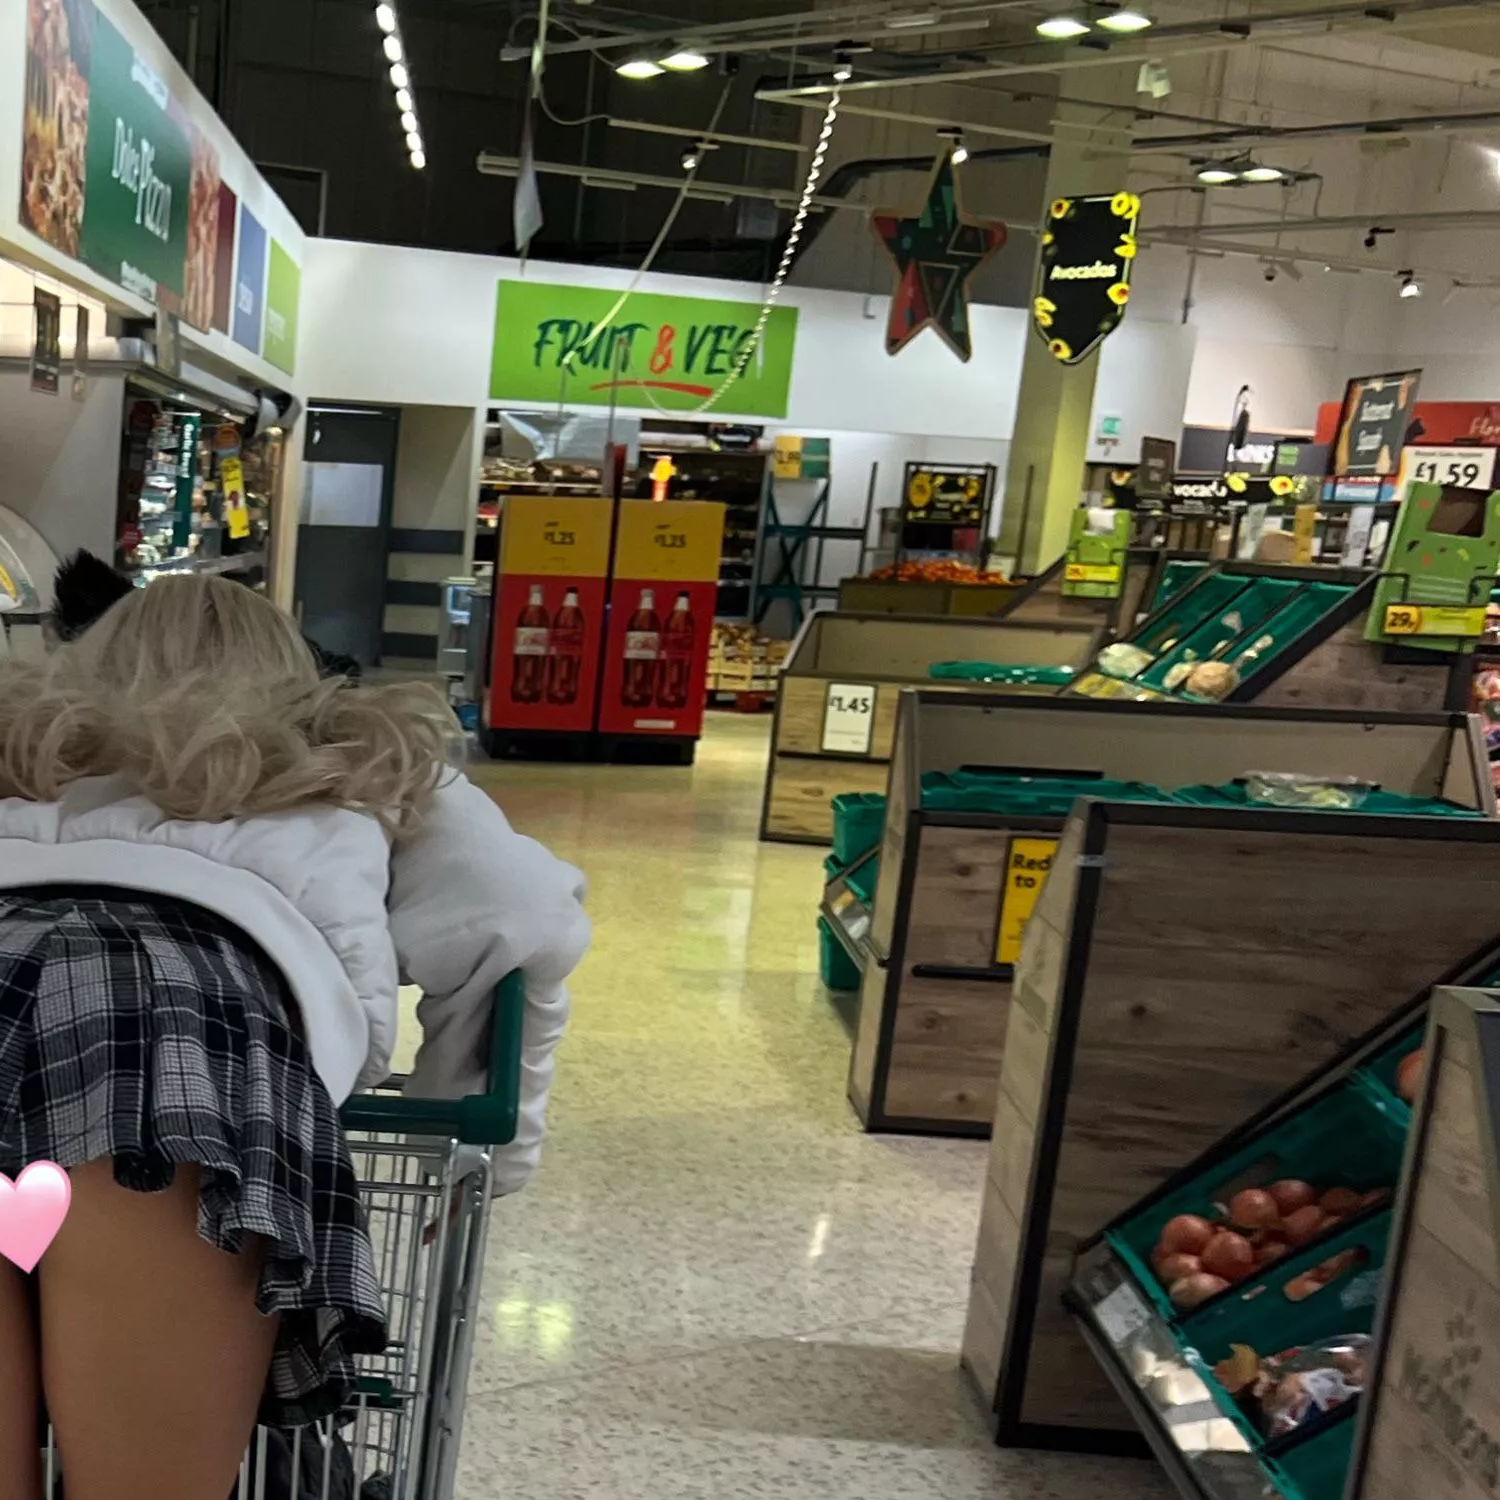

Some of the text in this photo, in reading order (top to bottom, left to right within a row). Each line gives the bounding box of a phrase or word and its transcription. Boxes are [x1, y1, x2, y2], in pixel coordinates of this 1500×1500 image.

[1050, 260, 1117, 280] Avocados
[534, 319, 757, 379] FRUIT & VEG
[1416, 462, 1479, 487] £1.59
[827, 696, 870, 714] £1.45
[1015, 874, 1036, 888] to
